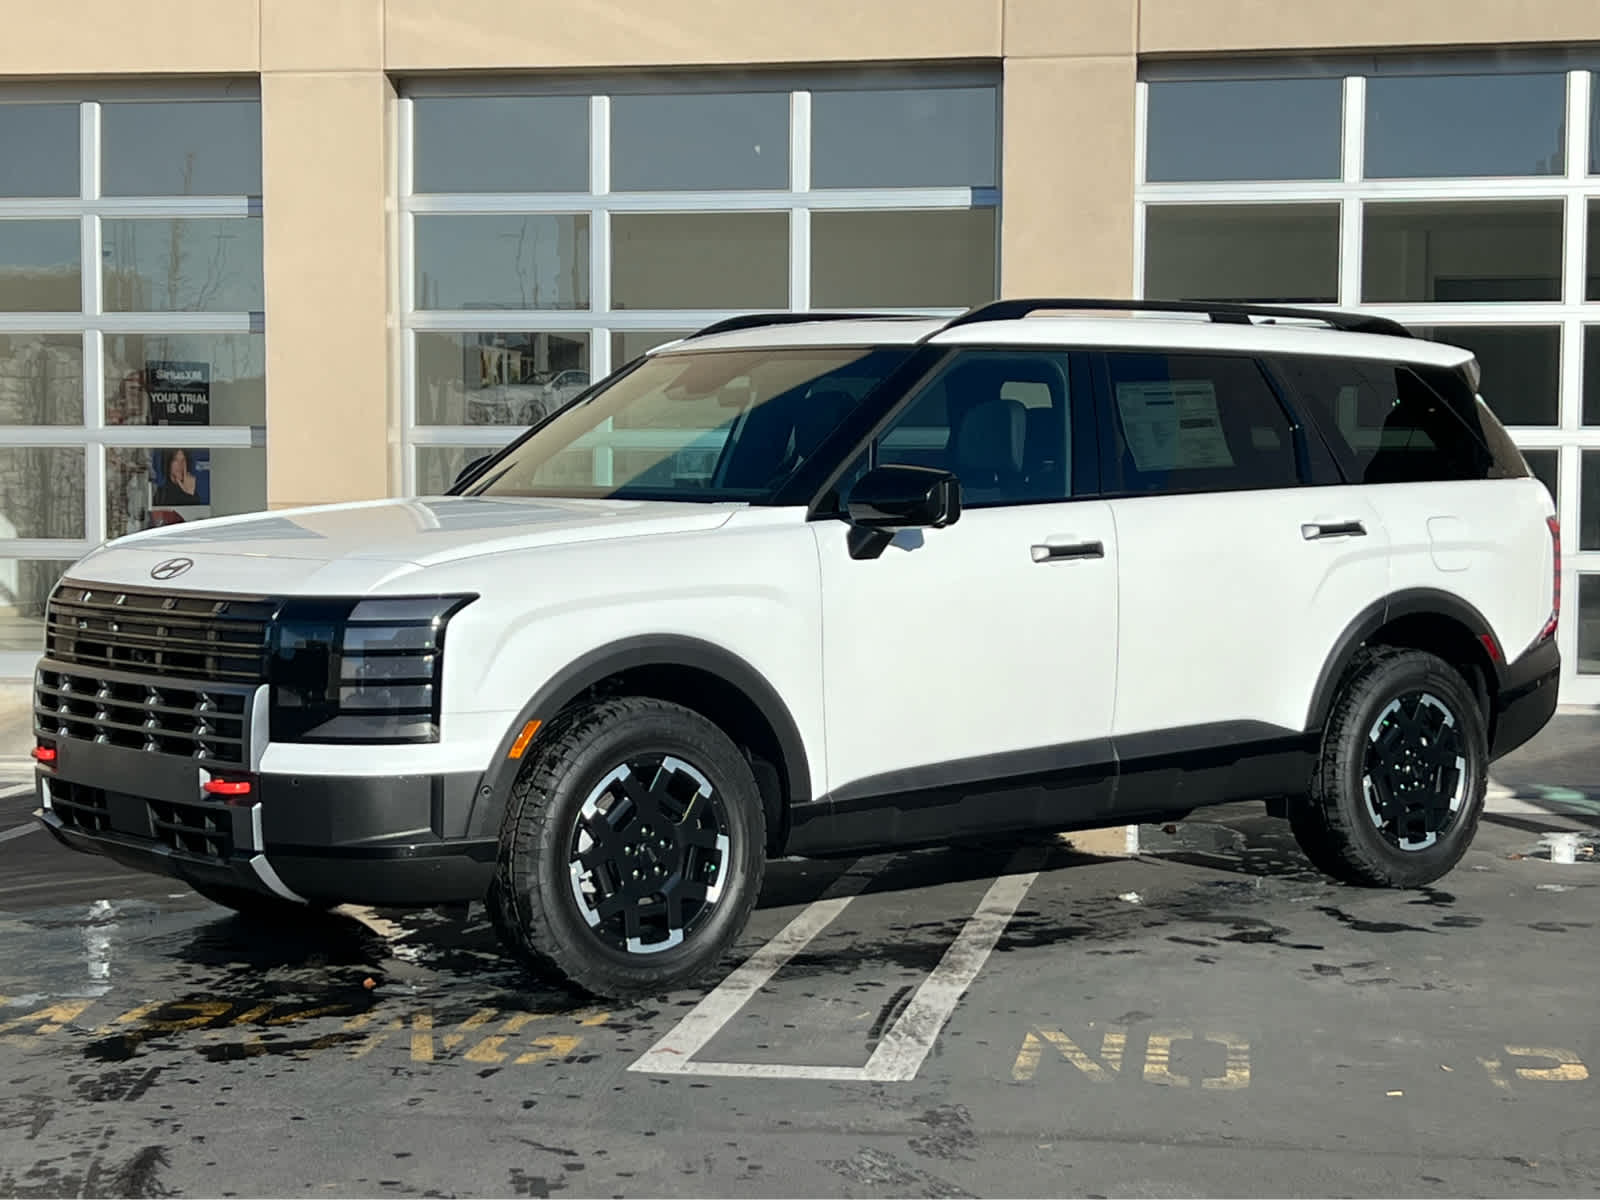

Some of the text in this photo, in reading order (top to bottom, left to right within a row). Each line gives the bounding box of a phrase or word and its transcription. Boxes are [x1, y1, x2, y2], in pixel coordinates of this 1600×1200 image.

[151, 393, 208, 404] YOUR TRIAL
[167, 403, 194, 414] IS ON
[1010, 1024, 1250, 1088] NO
